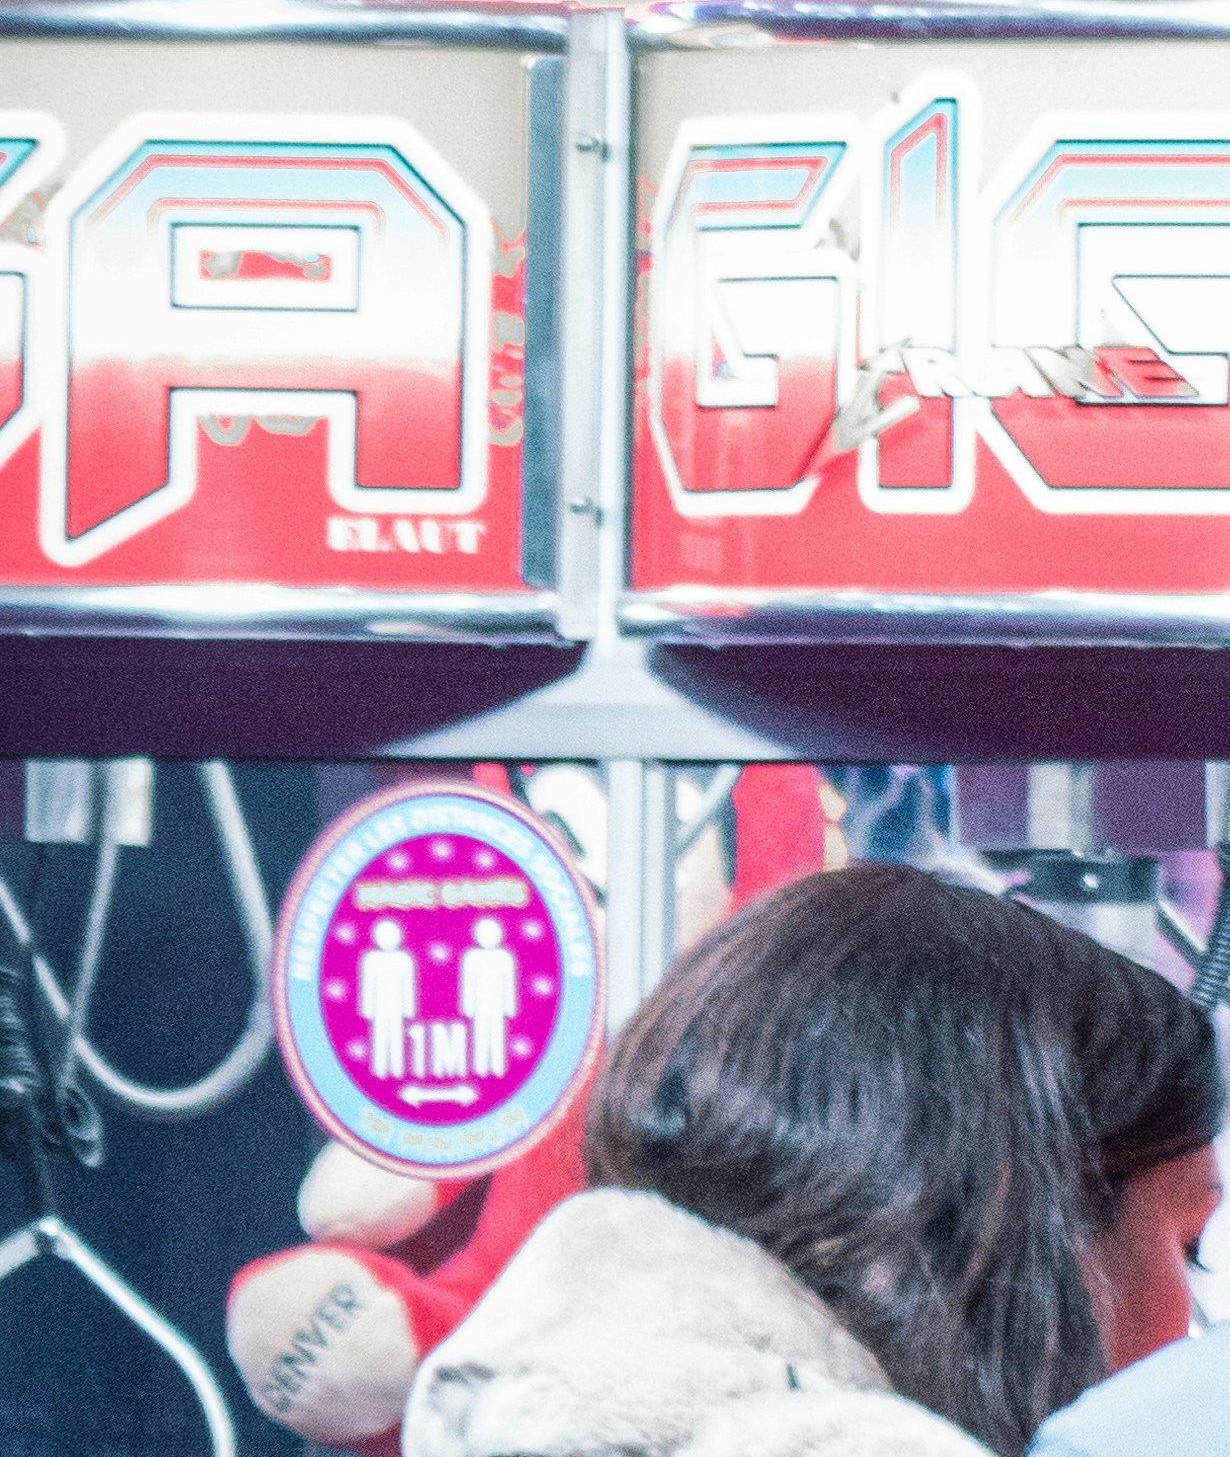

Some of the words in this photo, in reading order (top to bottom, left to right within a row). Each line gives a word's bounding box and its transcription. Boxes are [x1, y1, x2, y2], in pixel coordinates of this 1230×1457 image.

[0, 112, 491, 568] A
[327, 517, 486, 554] ELAUT
[408, 805, 533, 858] DISTANCES
[528, 853, 590, 979] SOCIALES
[408, 1022, 468, 1080] 1M
[259, 1281, 363, 1414] DENVER
